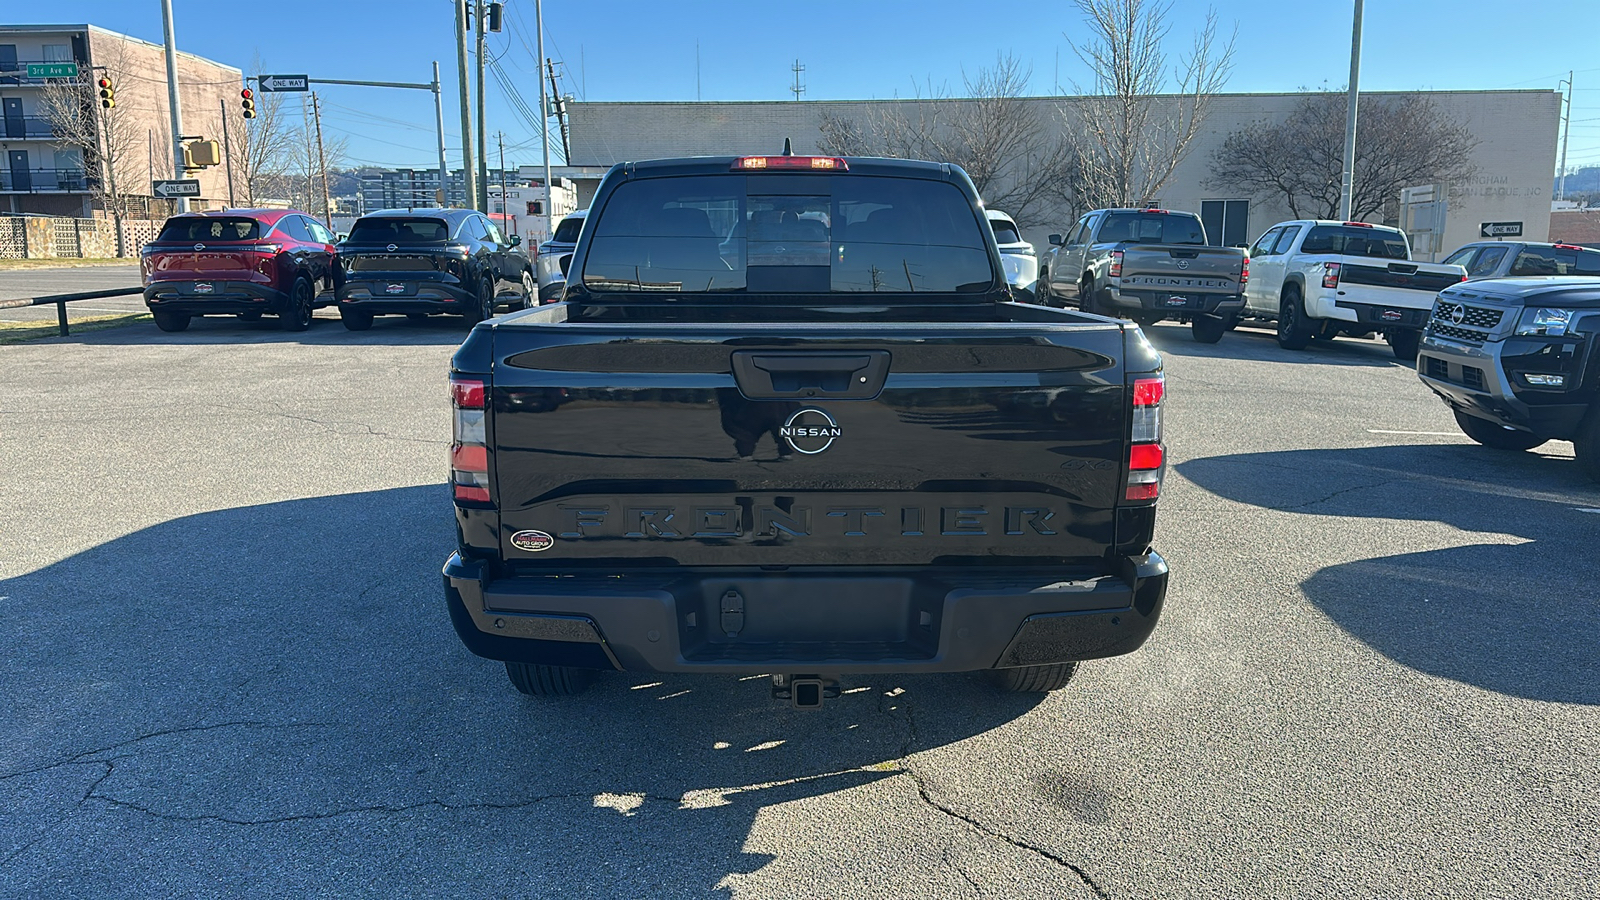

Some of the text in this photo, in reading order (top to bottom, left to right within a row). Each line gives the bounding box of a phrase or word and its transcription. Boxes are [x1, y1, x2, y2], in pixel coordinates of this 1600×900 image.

[32, 66, 73, 75] 3rd Ave N
[183, 184, 196, 192] WAY
[1132, 277, 1229, 288] FRONTIER
[780, 427, 841, 436] NISSAN
[557, 504, 1060, 537] FRONTIER
